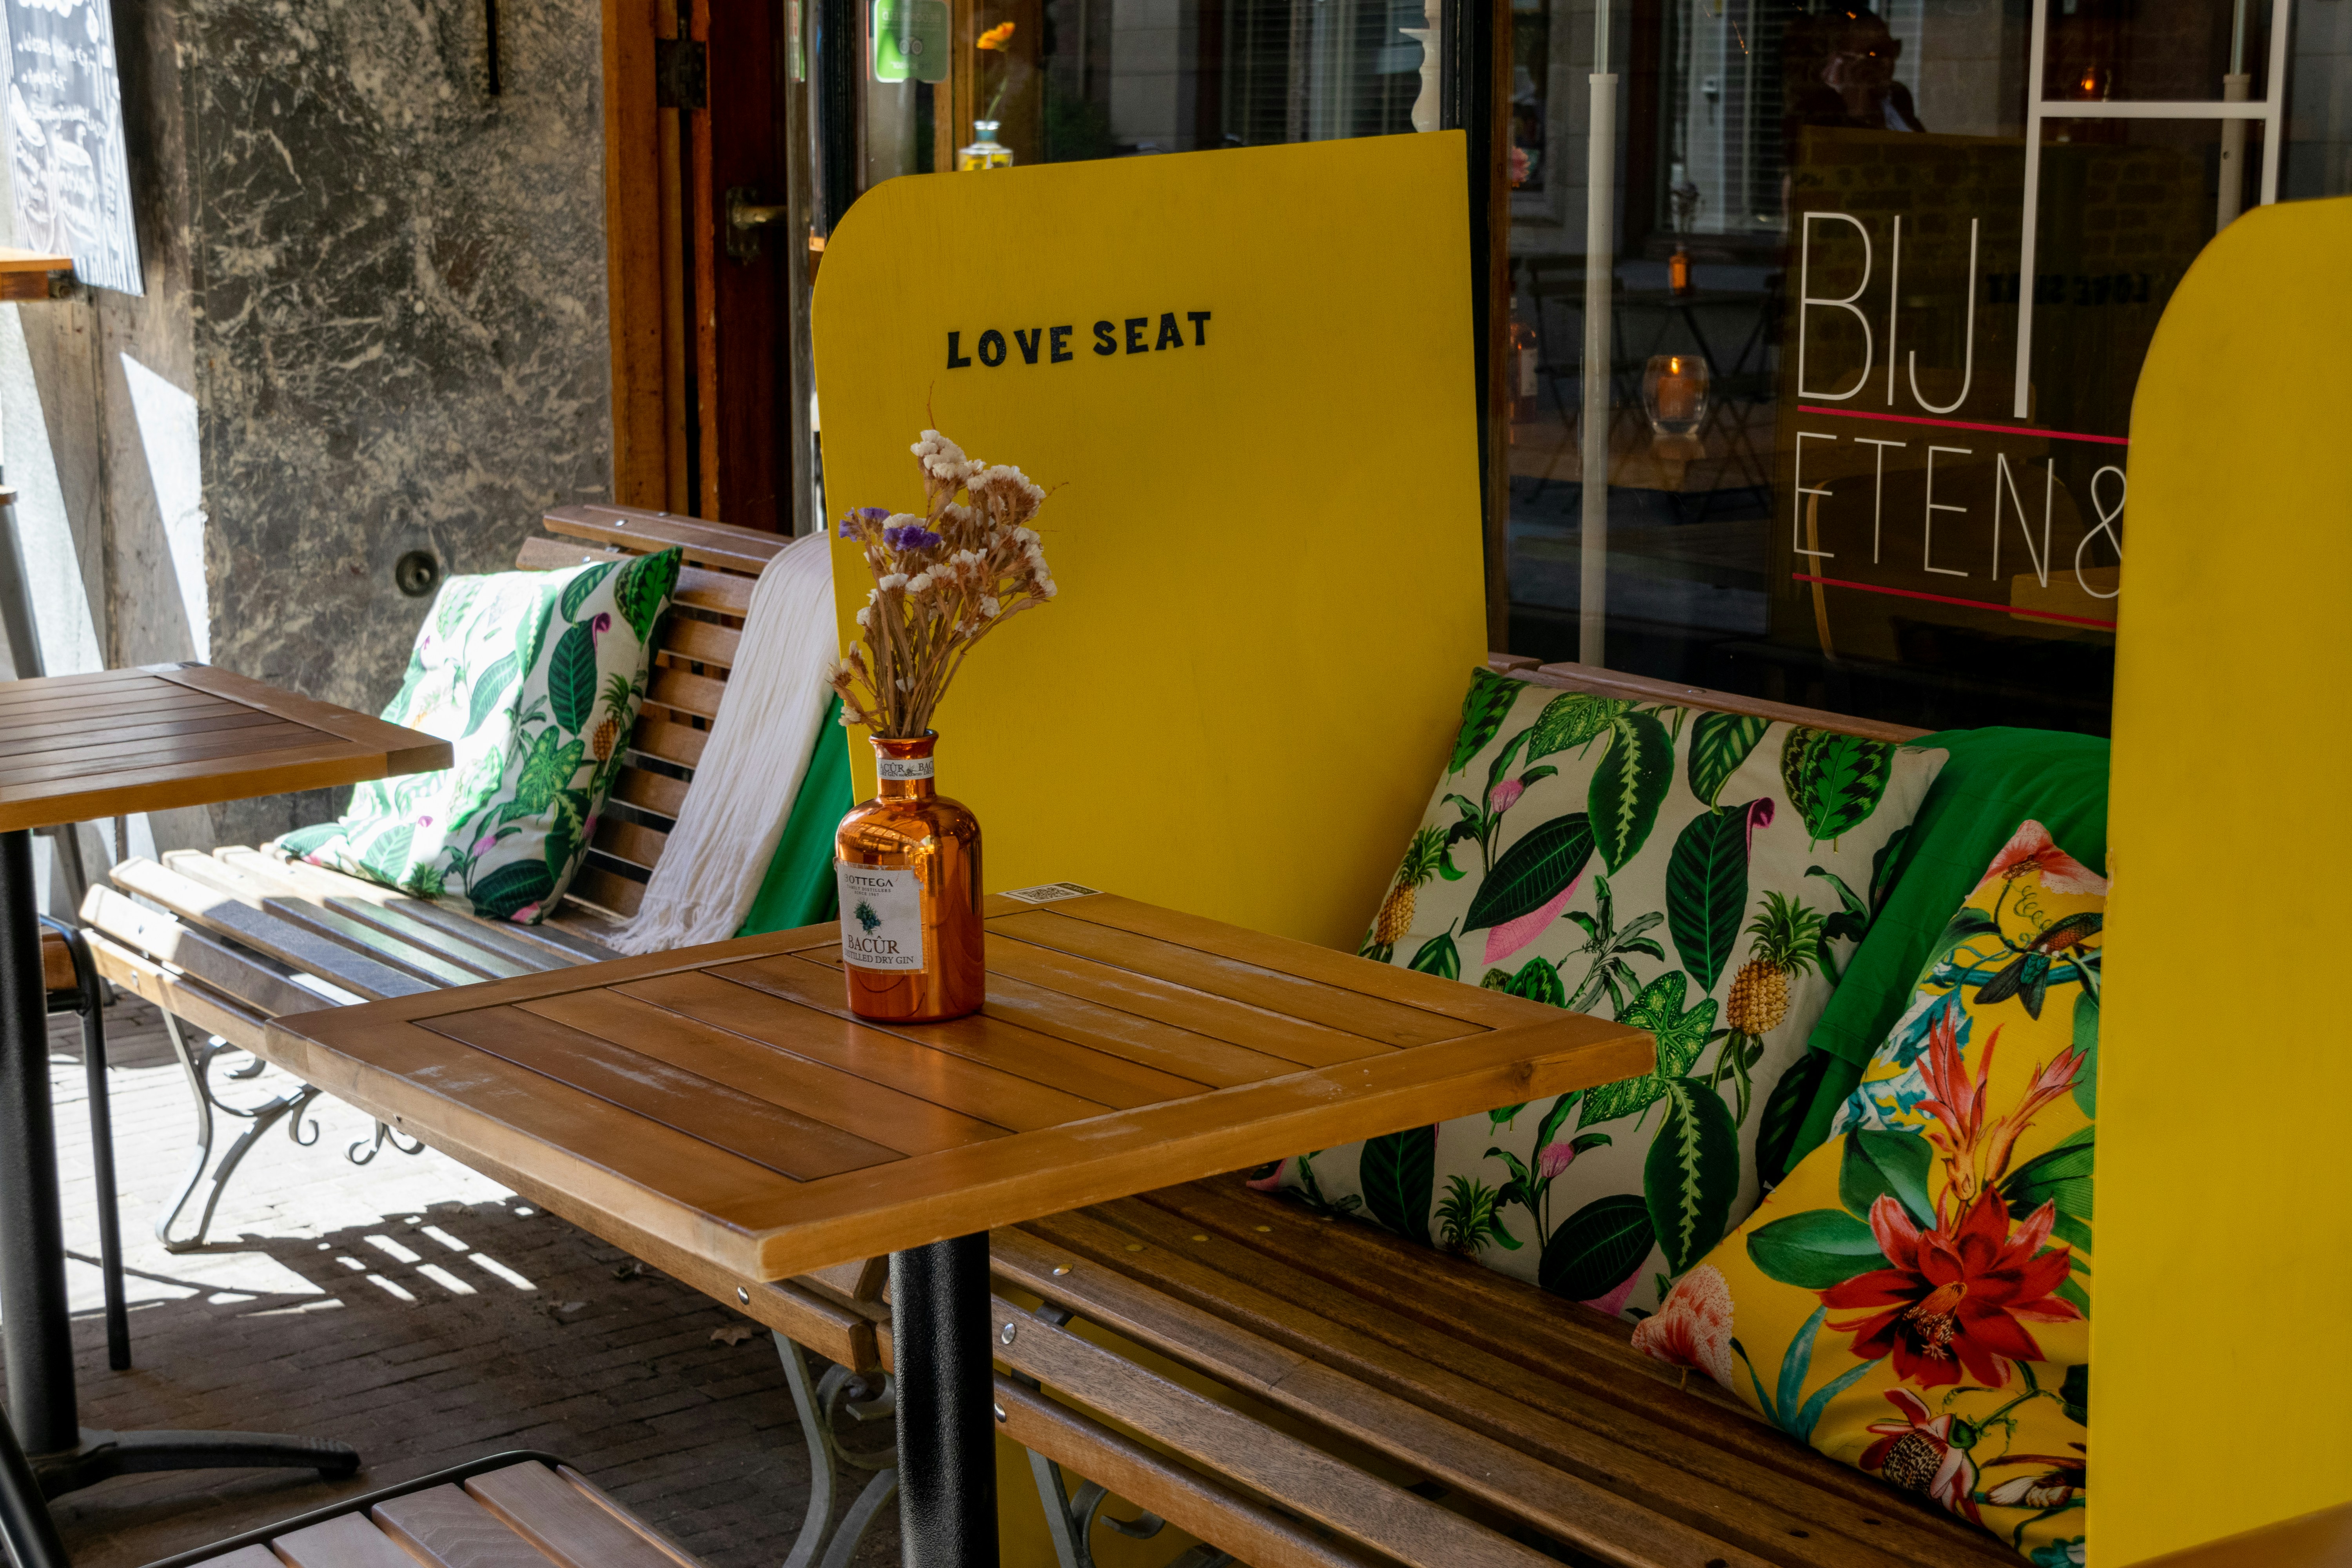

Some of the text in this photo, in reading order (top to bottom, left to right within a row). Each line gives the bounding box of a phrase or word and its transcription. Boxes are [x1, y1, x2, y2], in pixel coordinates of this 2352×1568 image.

[1798, 211, 1978, 414] BIJ
[947, 312, 1211, 369] LOVE SEAT
[844, 873, 893, 887] BOTTEGA
[848, 934, 900, 954] BACÛR
[875, 956, 894, 964] DRY
